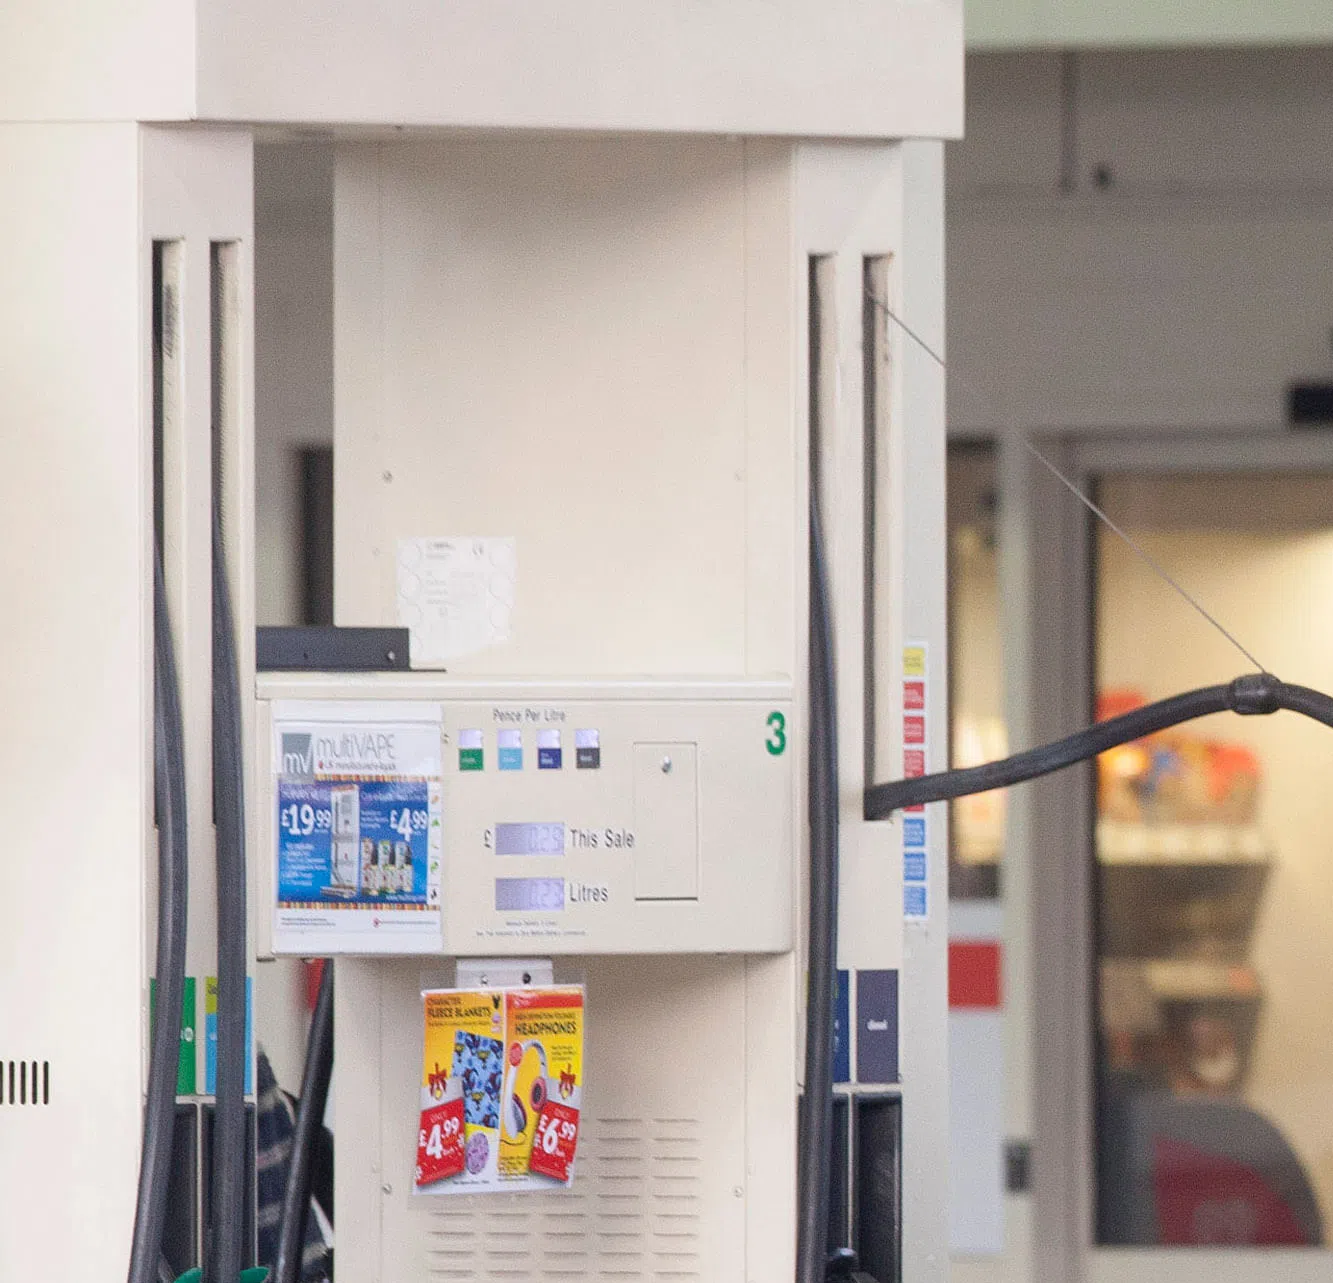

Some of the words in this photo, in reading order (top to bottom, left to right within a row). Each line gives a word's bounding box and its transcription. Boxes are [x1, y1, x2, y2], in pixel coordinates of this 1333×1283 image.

[493, 708, 521, 722] Pence
[525, 708, 540, 721] Per
[766, 711, 786, 756] 3
[484, 829, 492, 849] £
[570, 828, 598, 848] This
[604, 828, 635, 849] Sale
[569, 883, 609, 903] Litres
[515, 1021, 577, 1036] HEADPHONES
[419, 1116, 460, 1160] £4.99
[538, 1114, 577, 1155] £6.99
